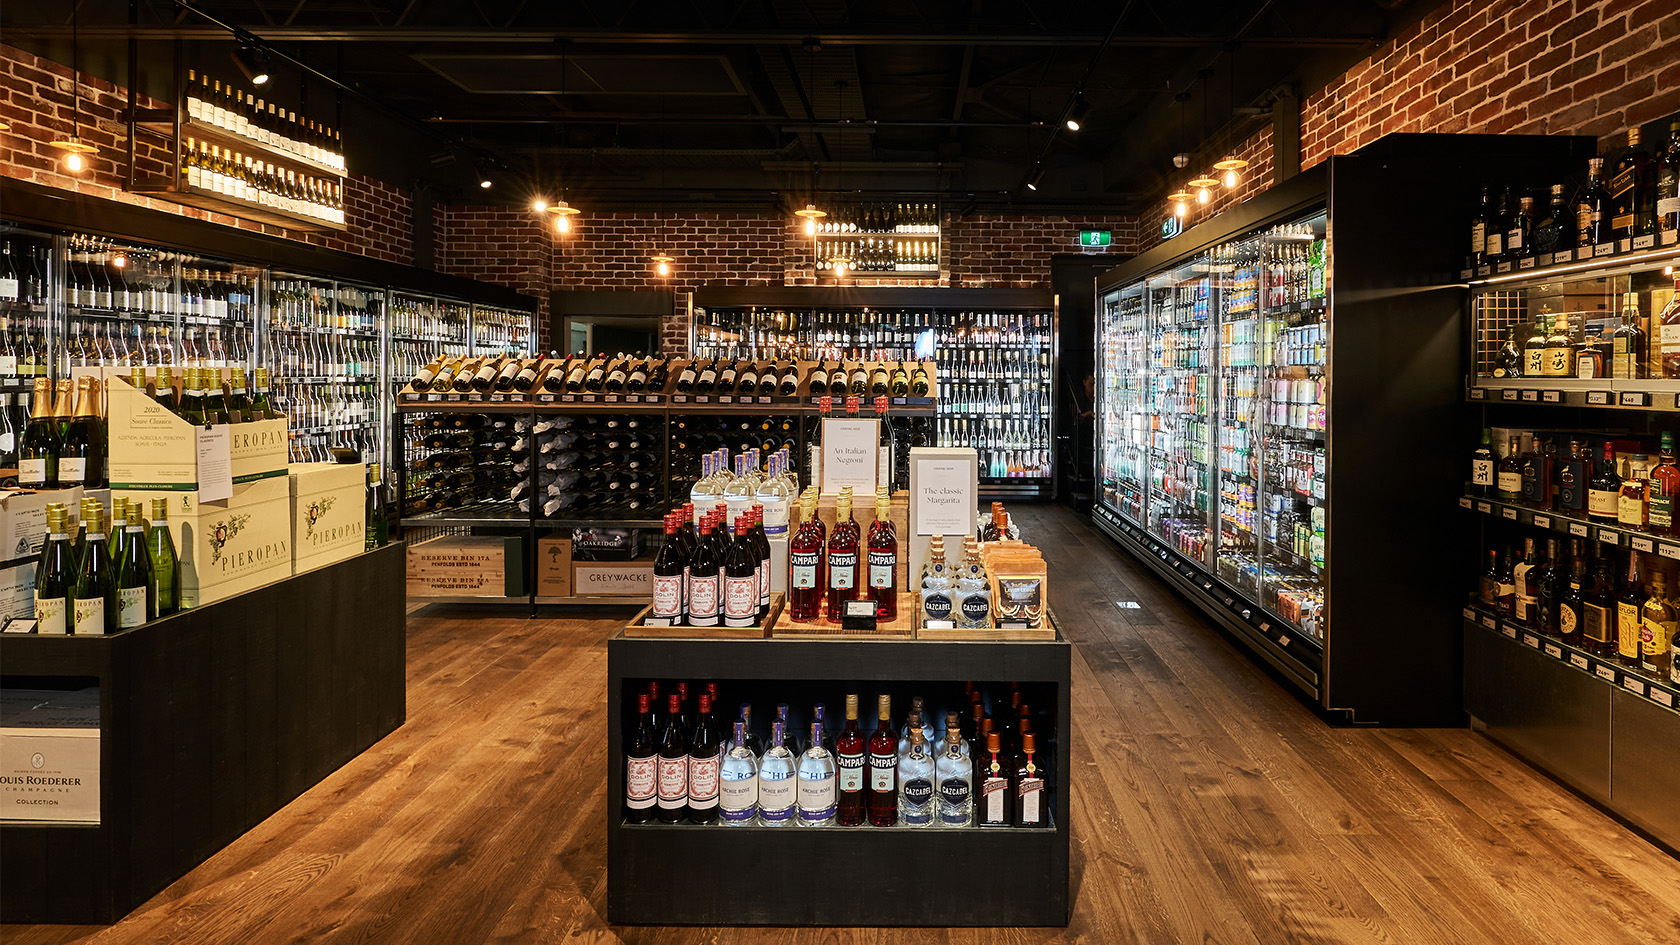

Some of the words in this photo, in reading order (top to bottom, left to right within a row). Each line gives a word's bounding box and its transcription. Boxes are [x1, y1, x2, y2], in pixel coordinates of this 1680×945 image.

[1530, 352, 1541, 371] 白州
[234, 430, 283, 449] EROPAN
[836, 456, 863, 465] Negroni
[927, 497, 960, 505] Margarita
[313, 521, 363, 546] PIEROPAN
[222, 540, 287, 571] PIEROPAN
[589, 574, 647, 582] GREYWACKE
[0, 776, 23, 784] OUIS
[26, 776, 81, 786] ROEDERER
